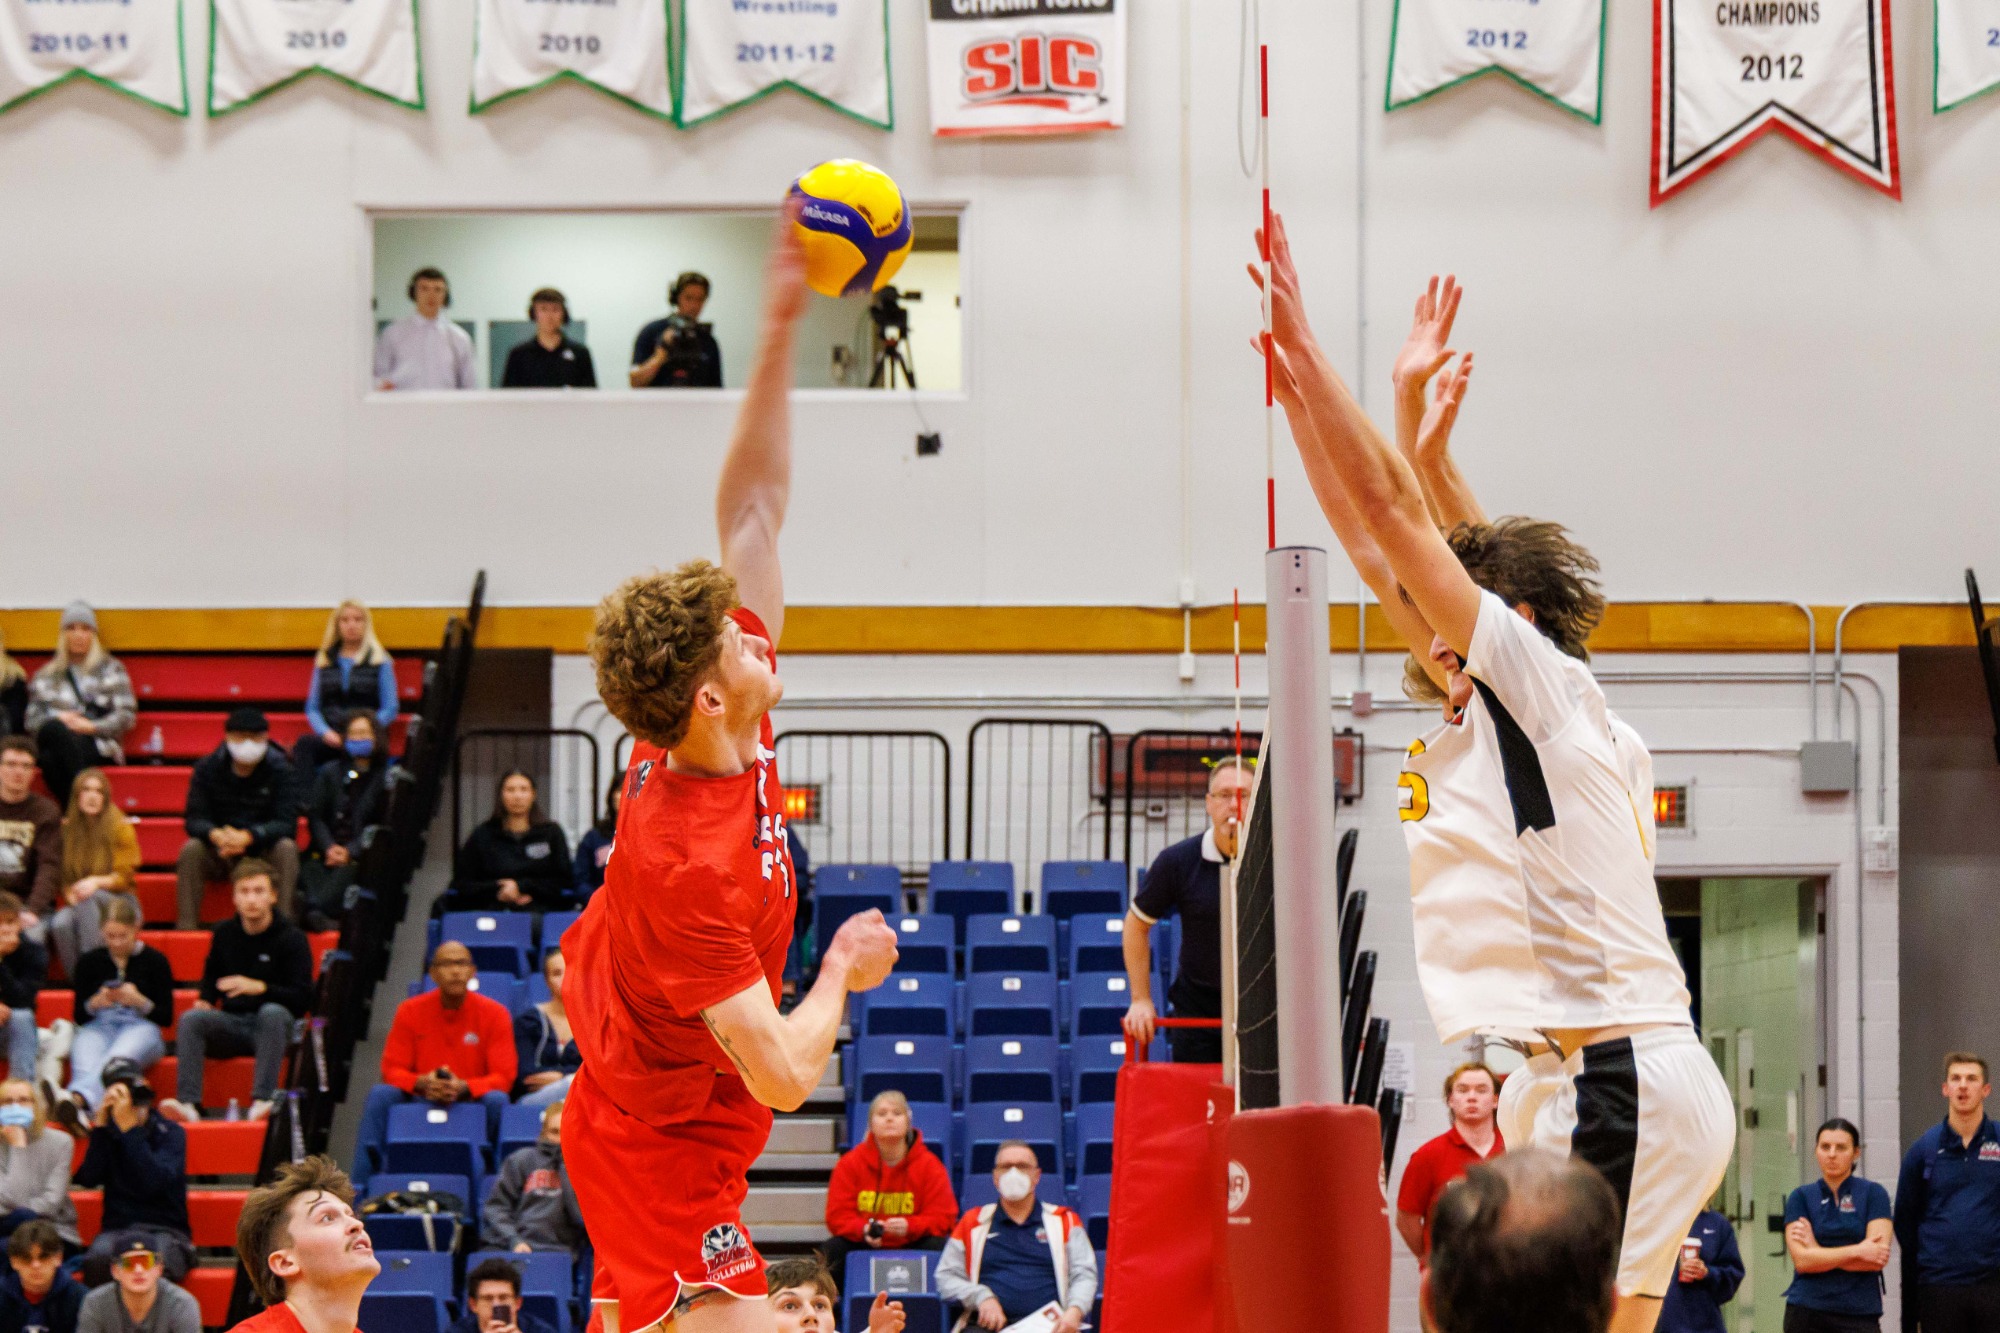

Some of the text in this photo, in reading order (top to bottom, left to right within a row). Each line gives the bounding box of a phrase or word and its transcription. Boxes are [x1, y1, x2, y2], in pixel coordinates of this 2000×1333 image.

[1717, 2, 1820, 25] CHAMPIONS
[30, 33, 128, 51] 2010-11
[285, 30, 347, 49] 2010
[540, 33, 601, 53] 2010
[1466, 29, 1527, 49] 2012
[736, 43, 834, 62] 2011-12
[963, 34, 1101, 98] SIC
[1741, 55, 1803, 81] 2012
[705, 1258, 757, 1282] VOLLEYBALL
